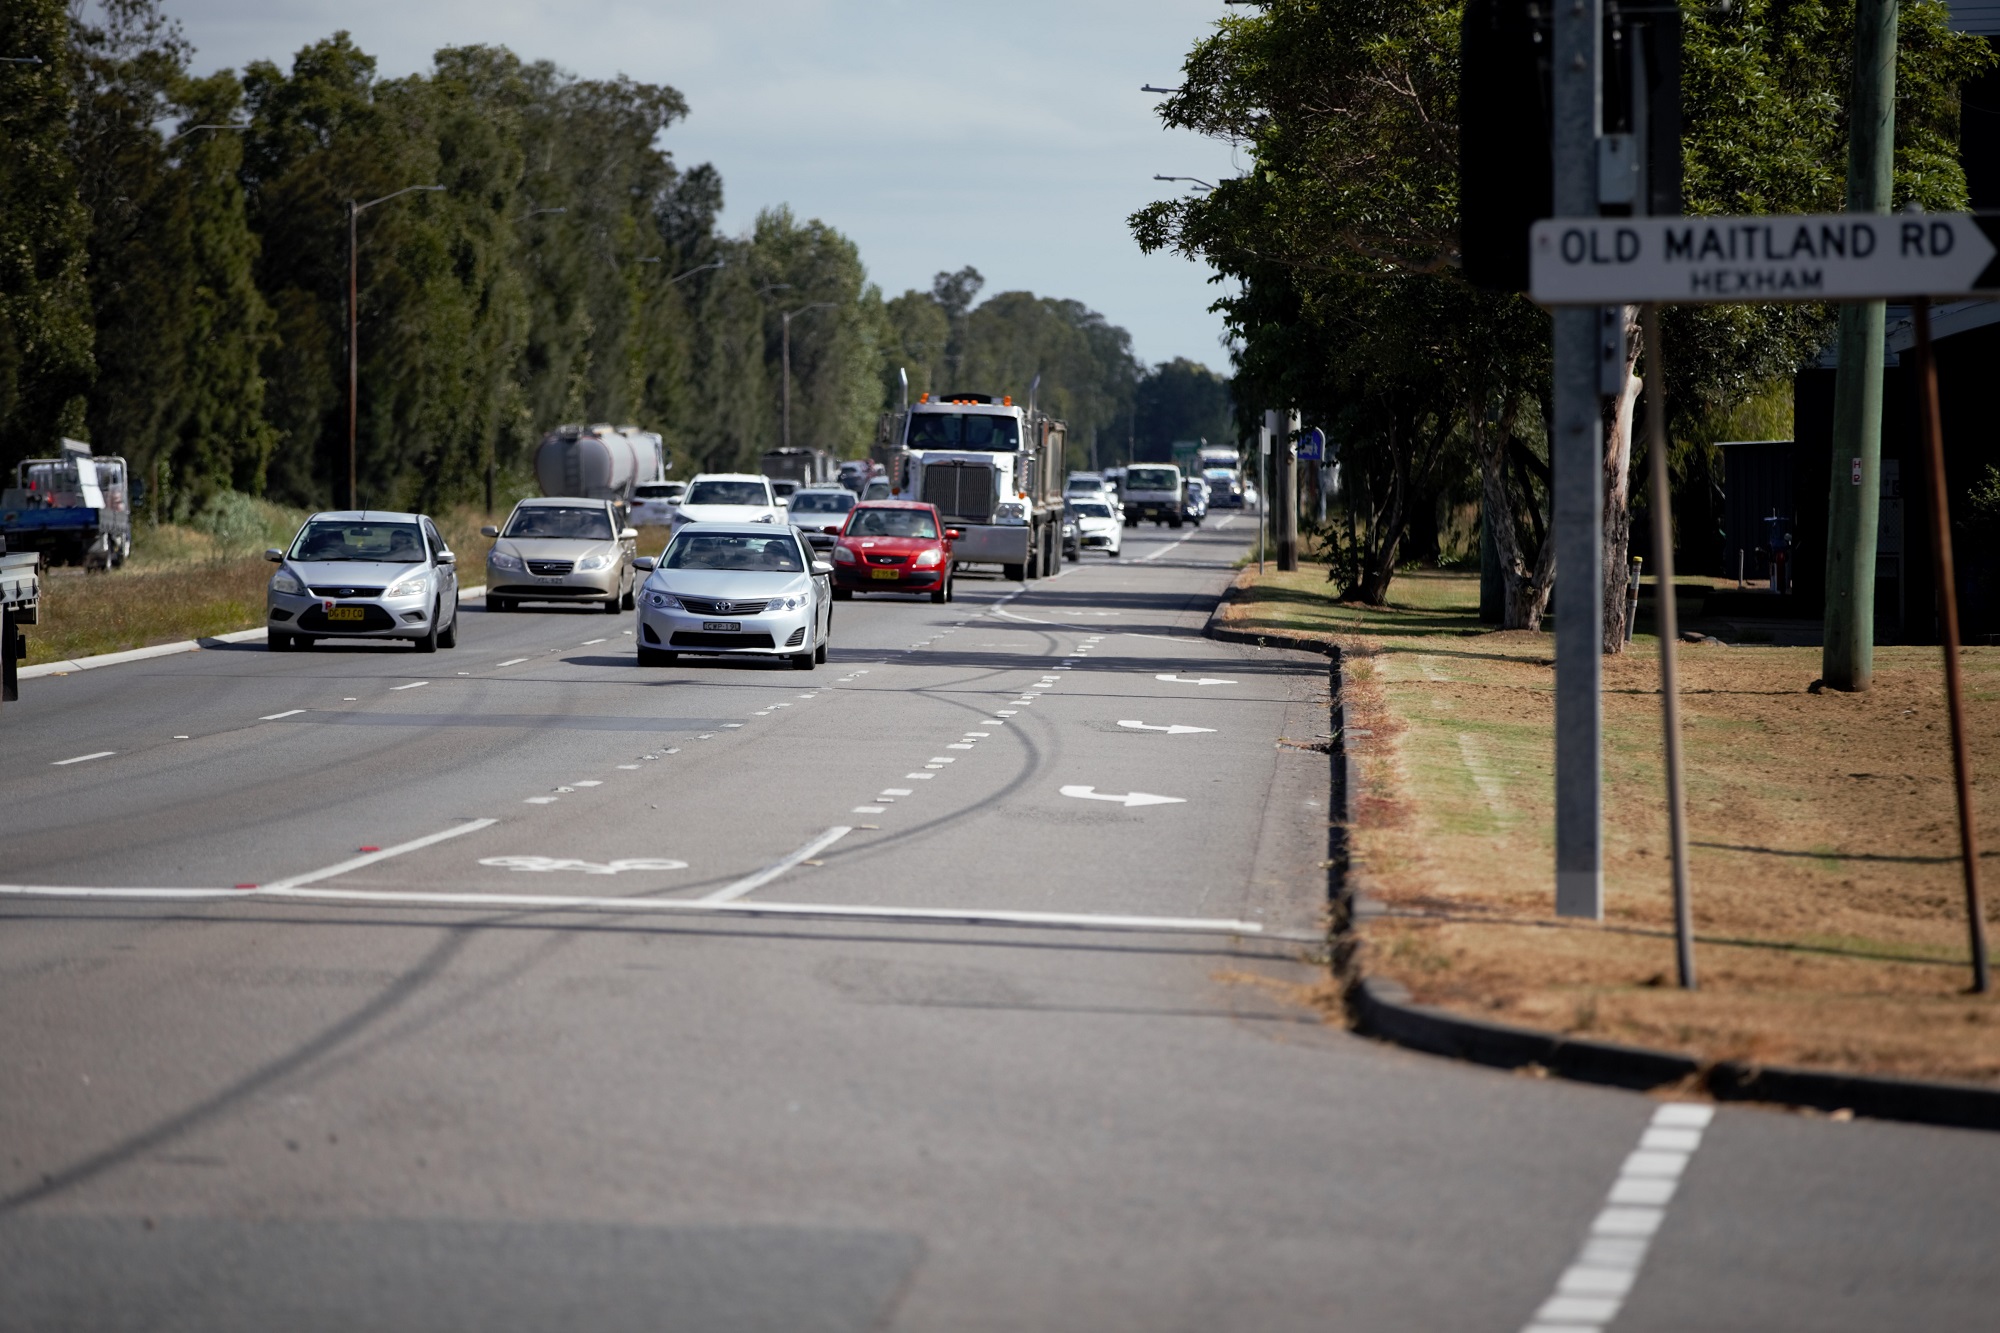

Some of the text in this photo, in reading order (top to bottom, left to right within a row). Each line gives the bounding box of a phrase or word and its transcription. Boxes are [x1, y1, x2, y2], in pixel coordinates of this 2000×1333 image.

[1561, 221, 1955, 264] OLD MAITLAND RD
[1690, 268, 1824, 294] HEXHAM
